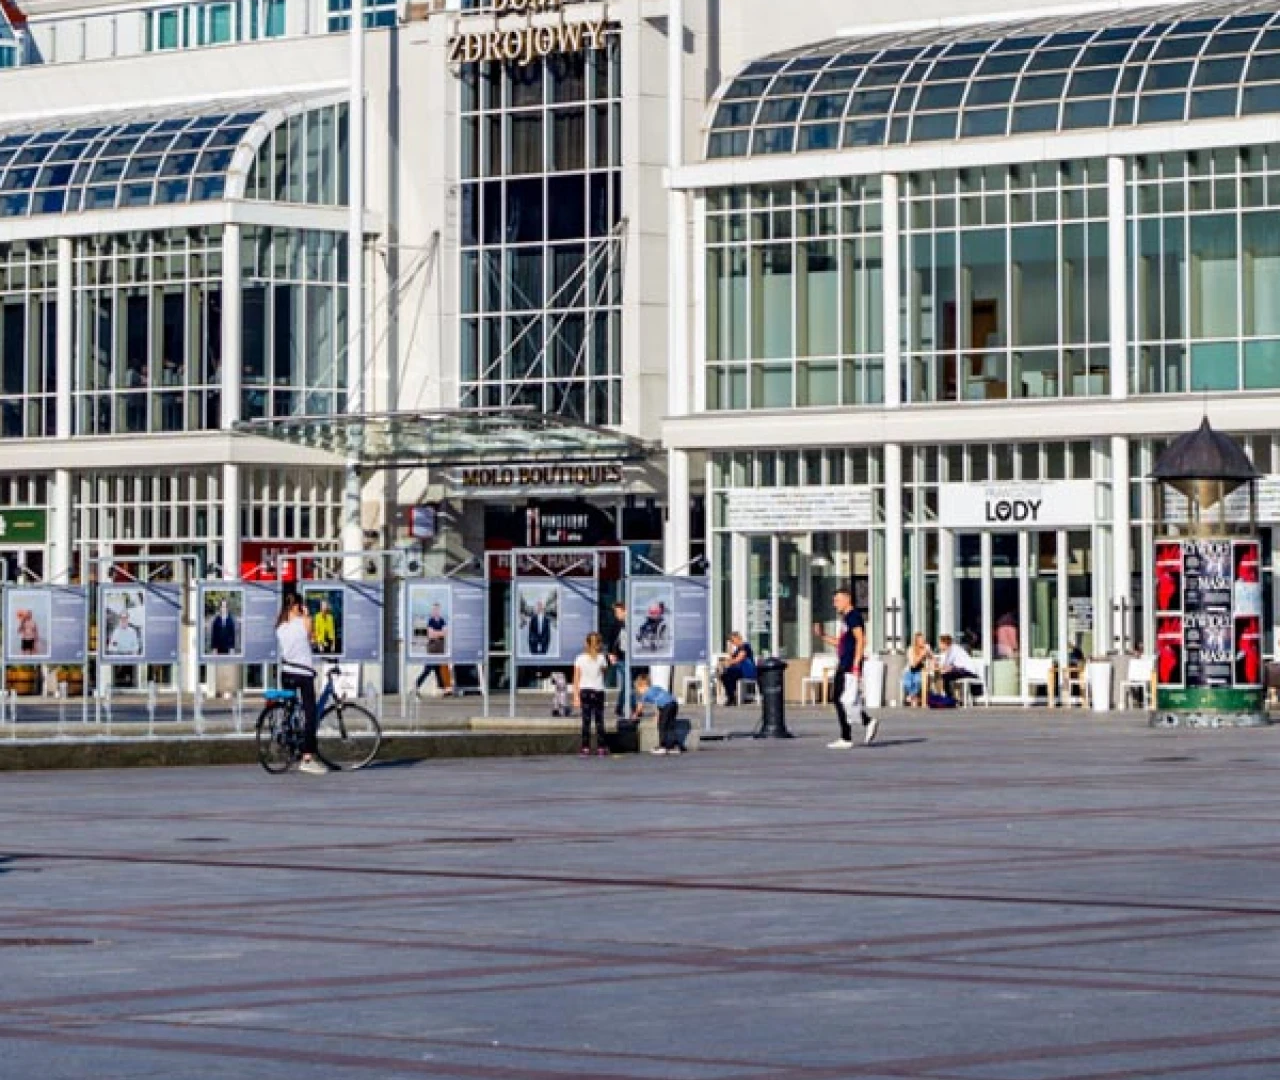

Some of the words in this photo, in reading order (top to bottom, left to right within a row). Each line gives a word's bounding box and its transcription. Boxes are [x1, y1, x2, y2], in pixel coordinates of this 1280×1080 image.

[447, 18, 608, 66] ZDROJOWY
[462, 467, 513, 487] MOLO
[518, 465, 622, 486] BOUTIQUES
[985, 498, 1043, 522] LODY
